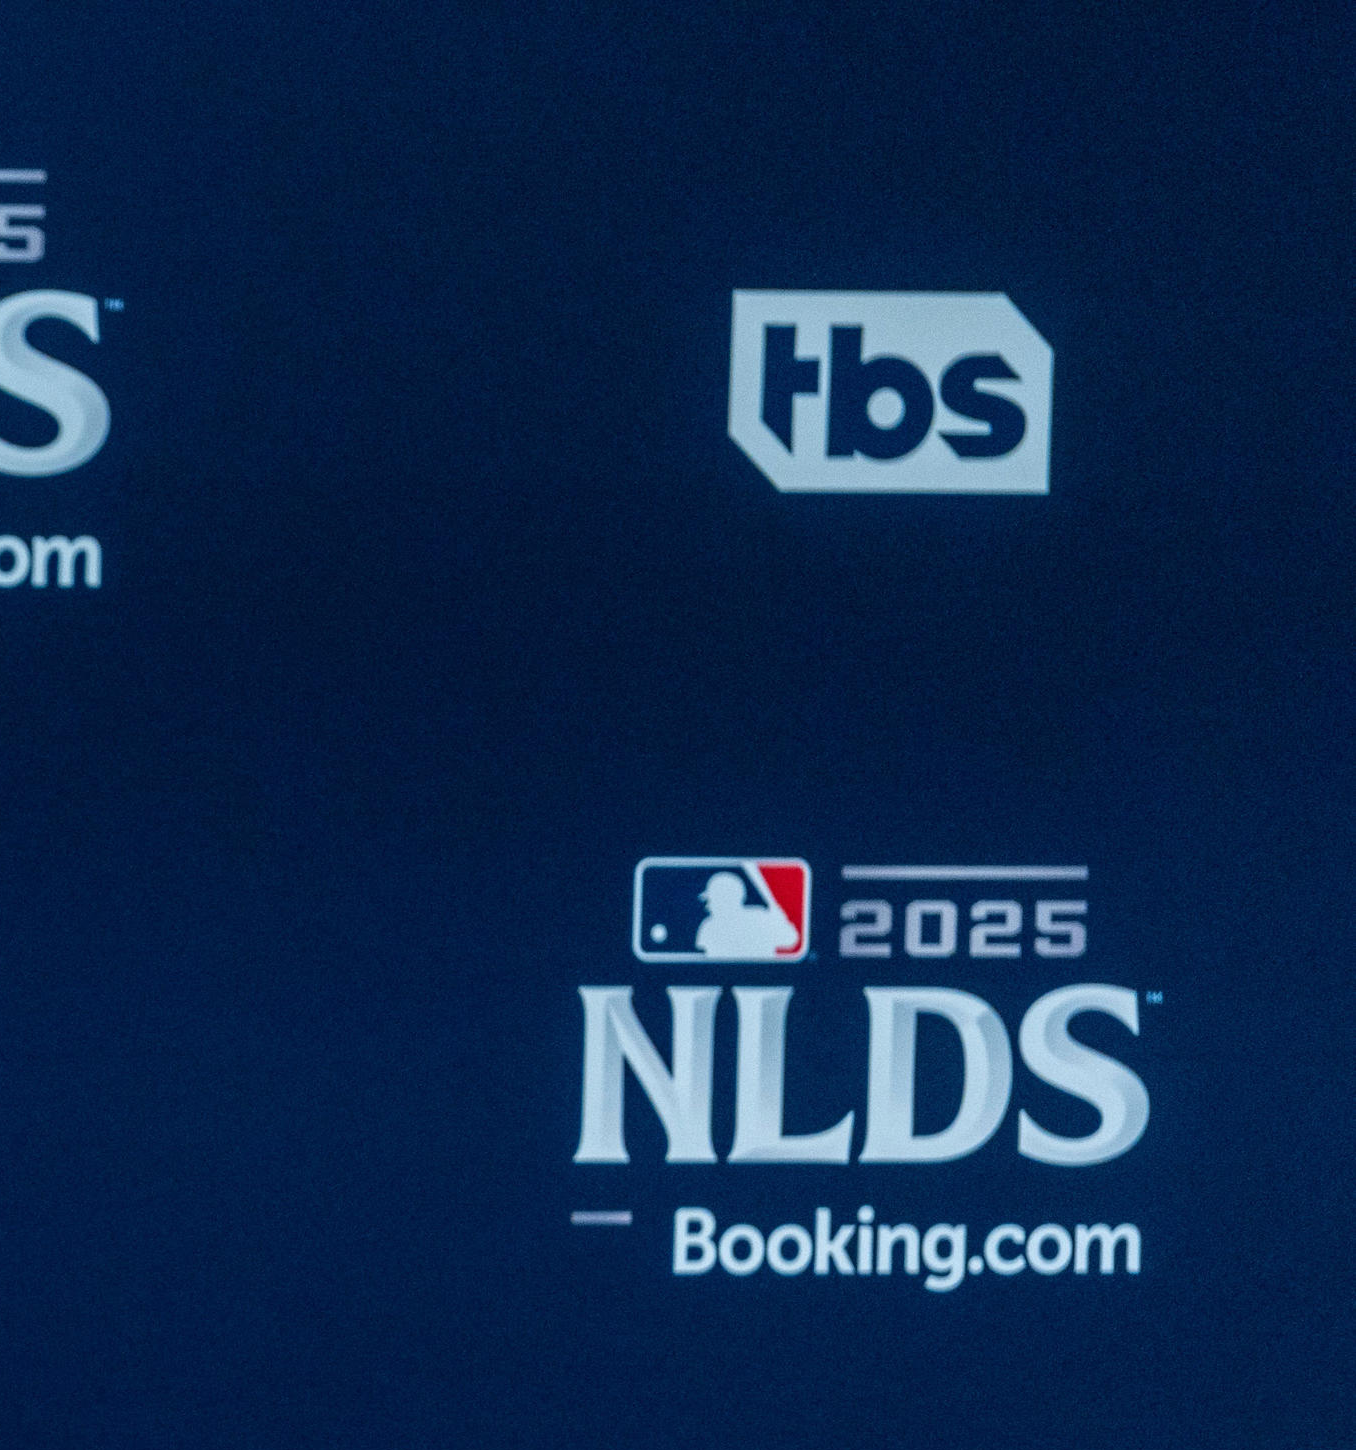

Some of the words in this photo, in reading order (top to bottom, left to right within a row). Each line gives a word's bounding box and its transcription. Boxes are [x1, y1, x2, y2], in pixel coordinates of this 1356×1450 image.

[760, 323, 1028, 461] tbs
[839, 900, 1088, 958] 2025
[572, 983, 1151, 1167] NLDS
[672, 1204, 1142, 1293] Booking.com
